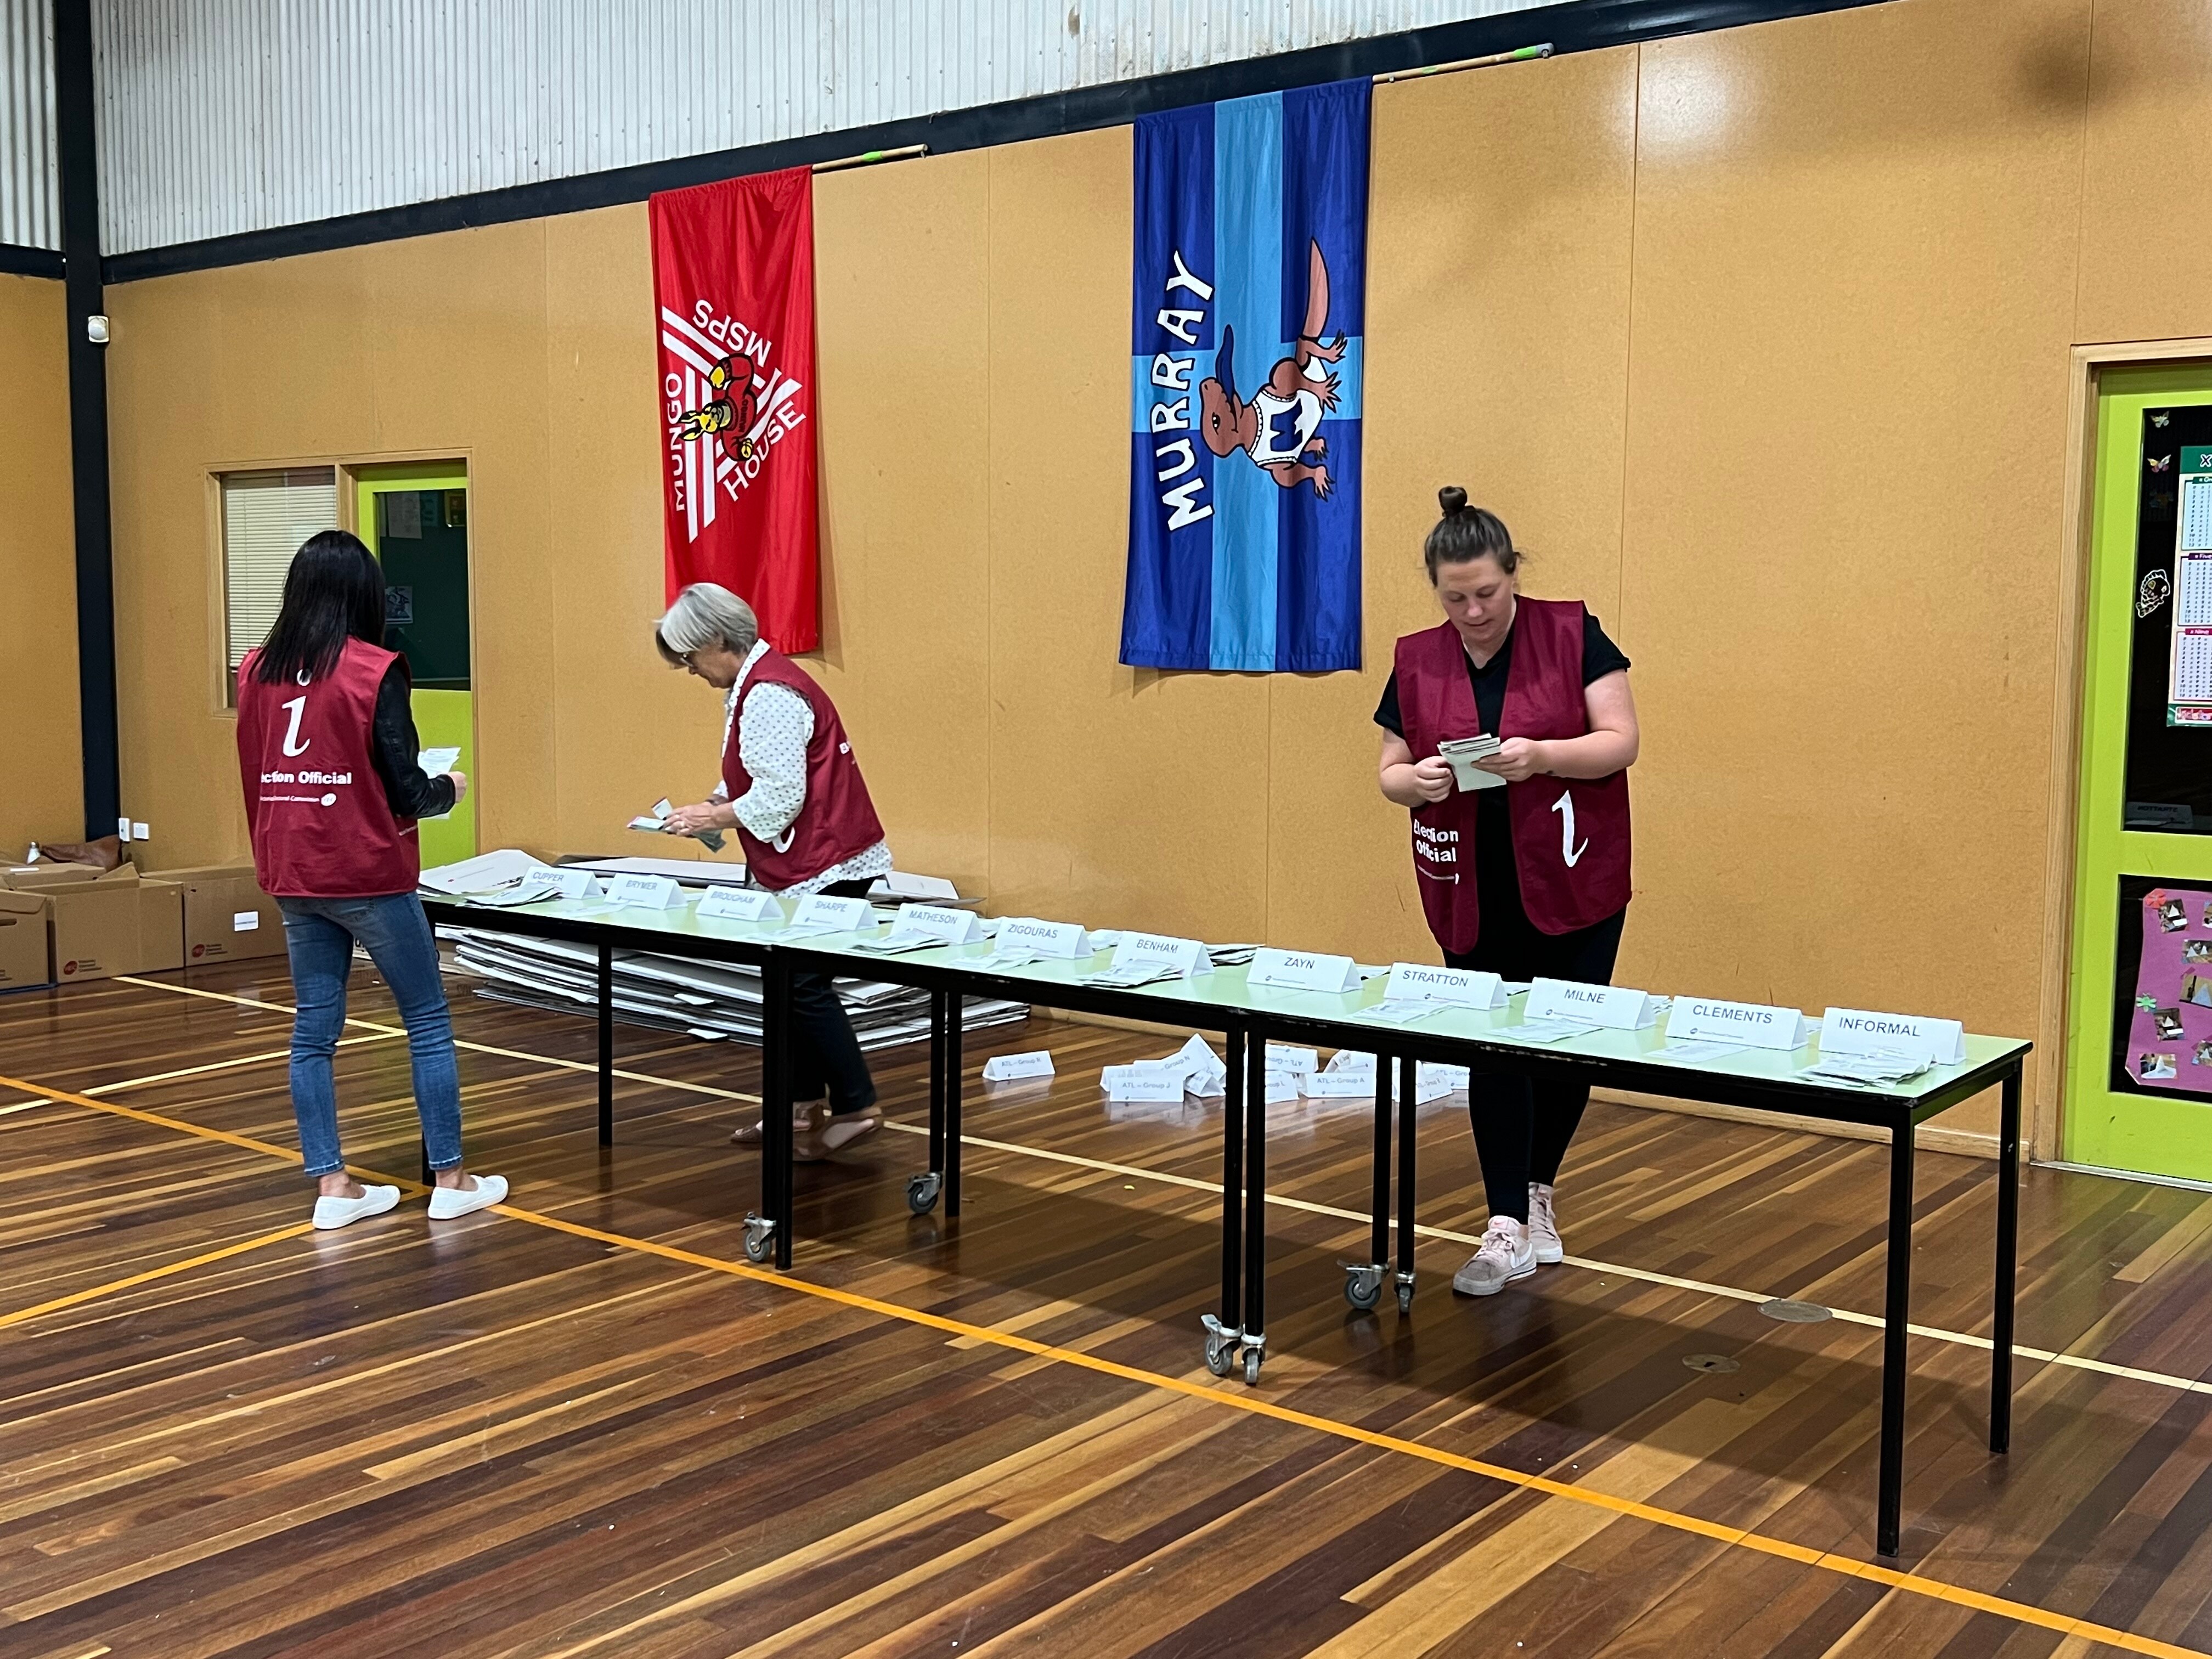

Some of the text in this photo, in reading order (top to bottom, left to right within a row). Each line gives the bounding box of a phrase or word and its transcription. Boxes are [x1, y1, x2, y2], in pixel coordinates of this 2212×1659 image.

[692, 299, 771, 368] MSPS
[1150, 251, 1214, 531] MURRAY
[665, 373, 685, 512] MUNGO
[724, 402, 806, 502] HOUSE
[298, 771, 352, 784] Official
[1414, 819, 1459, 843] Election
[1416, 839, 1457, 862] Official
[533, 872, 564, 882] CUPPER
[909, 910, 958, 924] MATHESON
[1008, 924, 1058, 938] ZIGOURAS
[1137, 939, 1178, 953] BENHAM
[1284, 957, 1315, 969] ZAYN
[1403, 970, 1469, 987] STRATTON
[1564, 989, 1606, 1003] MILNE
[1692, 1005, 1773, 1024] CLEMENTS
[1839, 1017, 1921, 1036] INFORMAL
